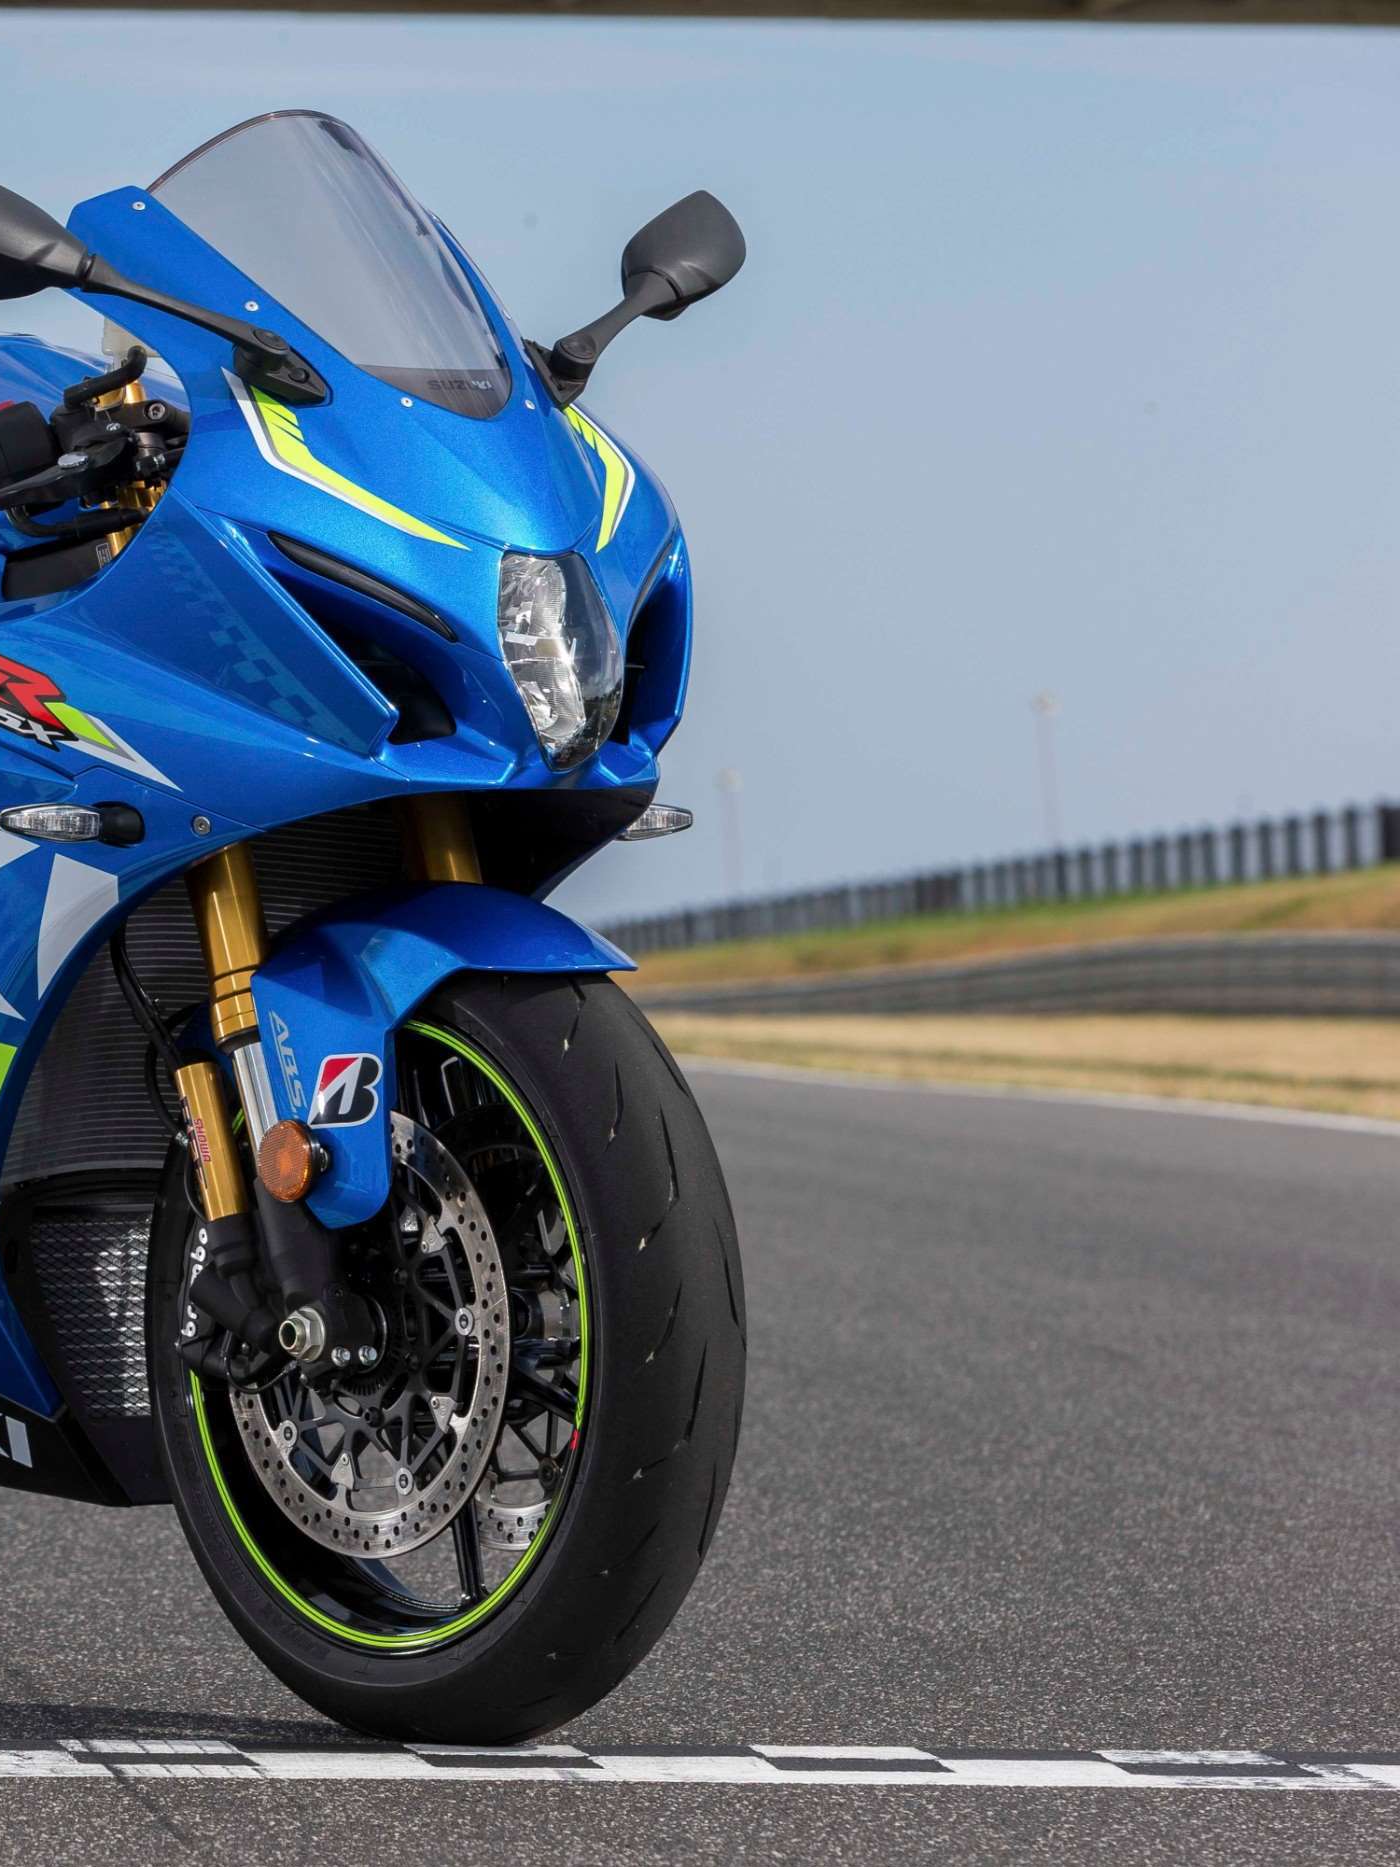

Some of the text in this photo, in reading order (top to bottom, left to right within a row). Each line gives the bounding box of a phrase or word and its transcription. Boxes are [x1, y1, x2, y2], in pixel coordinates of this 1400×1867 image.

[268, 1009, 309, 1118] ABS
[193, 1115, 212, 1163] SHOWA
[180, 1227, 209, 1338] brbo
